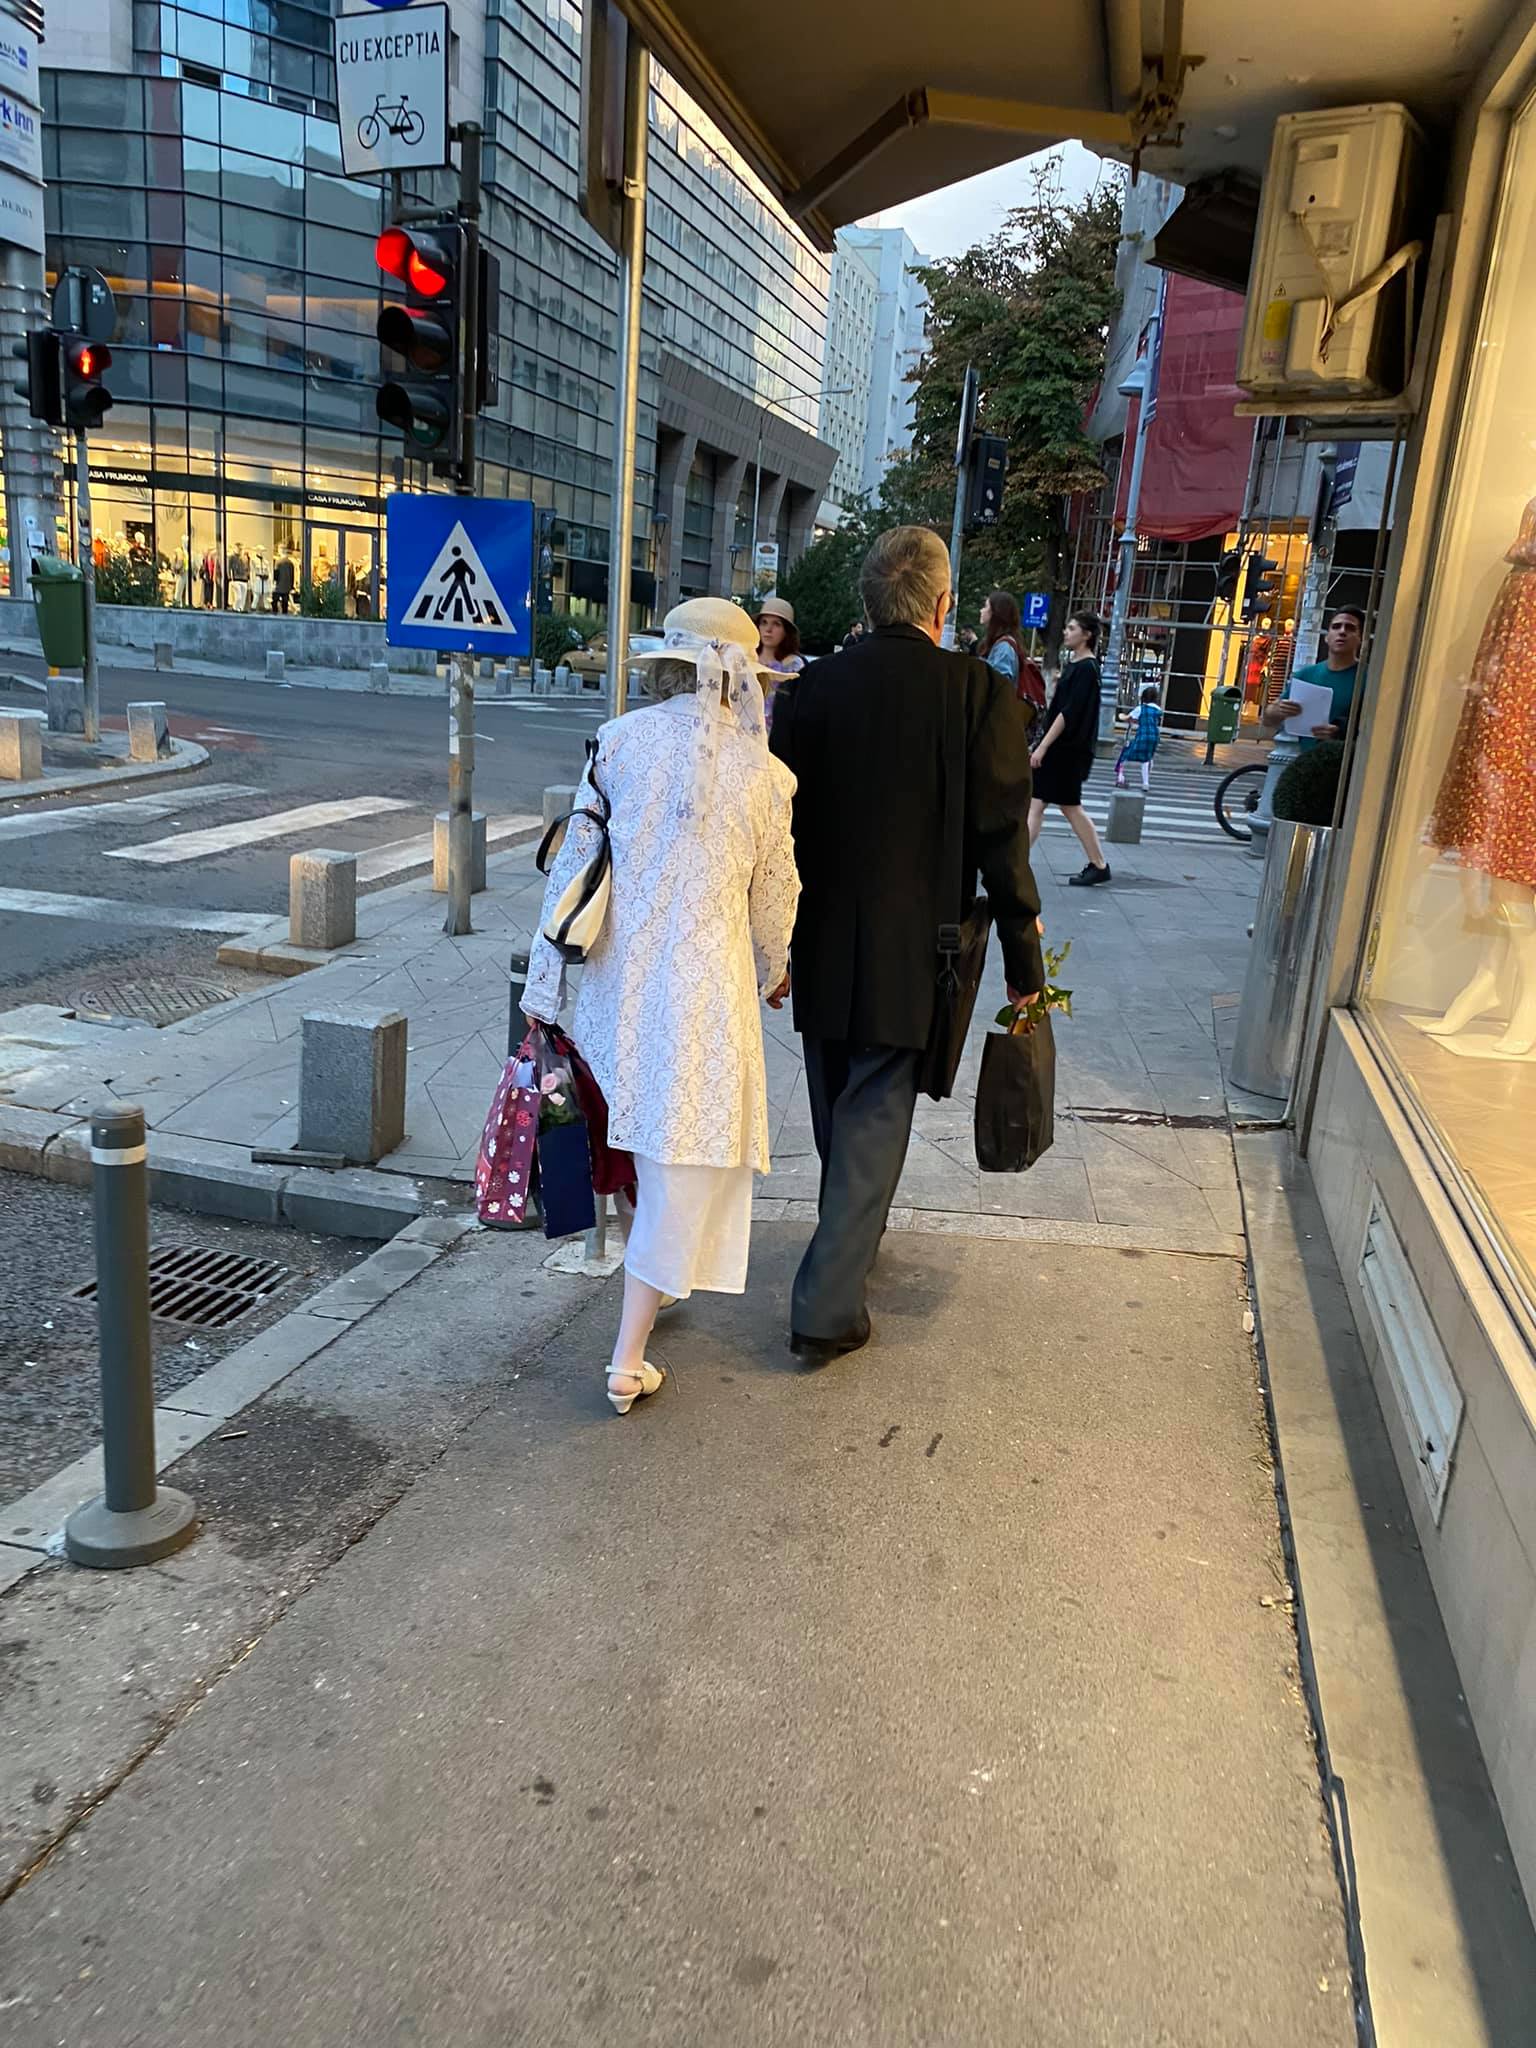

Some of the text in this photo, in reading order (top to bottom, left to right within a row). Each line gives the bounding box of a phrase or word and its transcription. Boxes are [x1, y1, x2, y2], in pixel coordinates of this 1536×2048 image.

[340, 40, 359, 64] CU
[15, 104, 34, 135] inn
[88, 470, 105, 480] ASA
[308, 494, 328, 504] CASA
[1030, 596, 1044, 615] P
